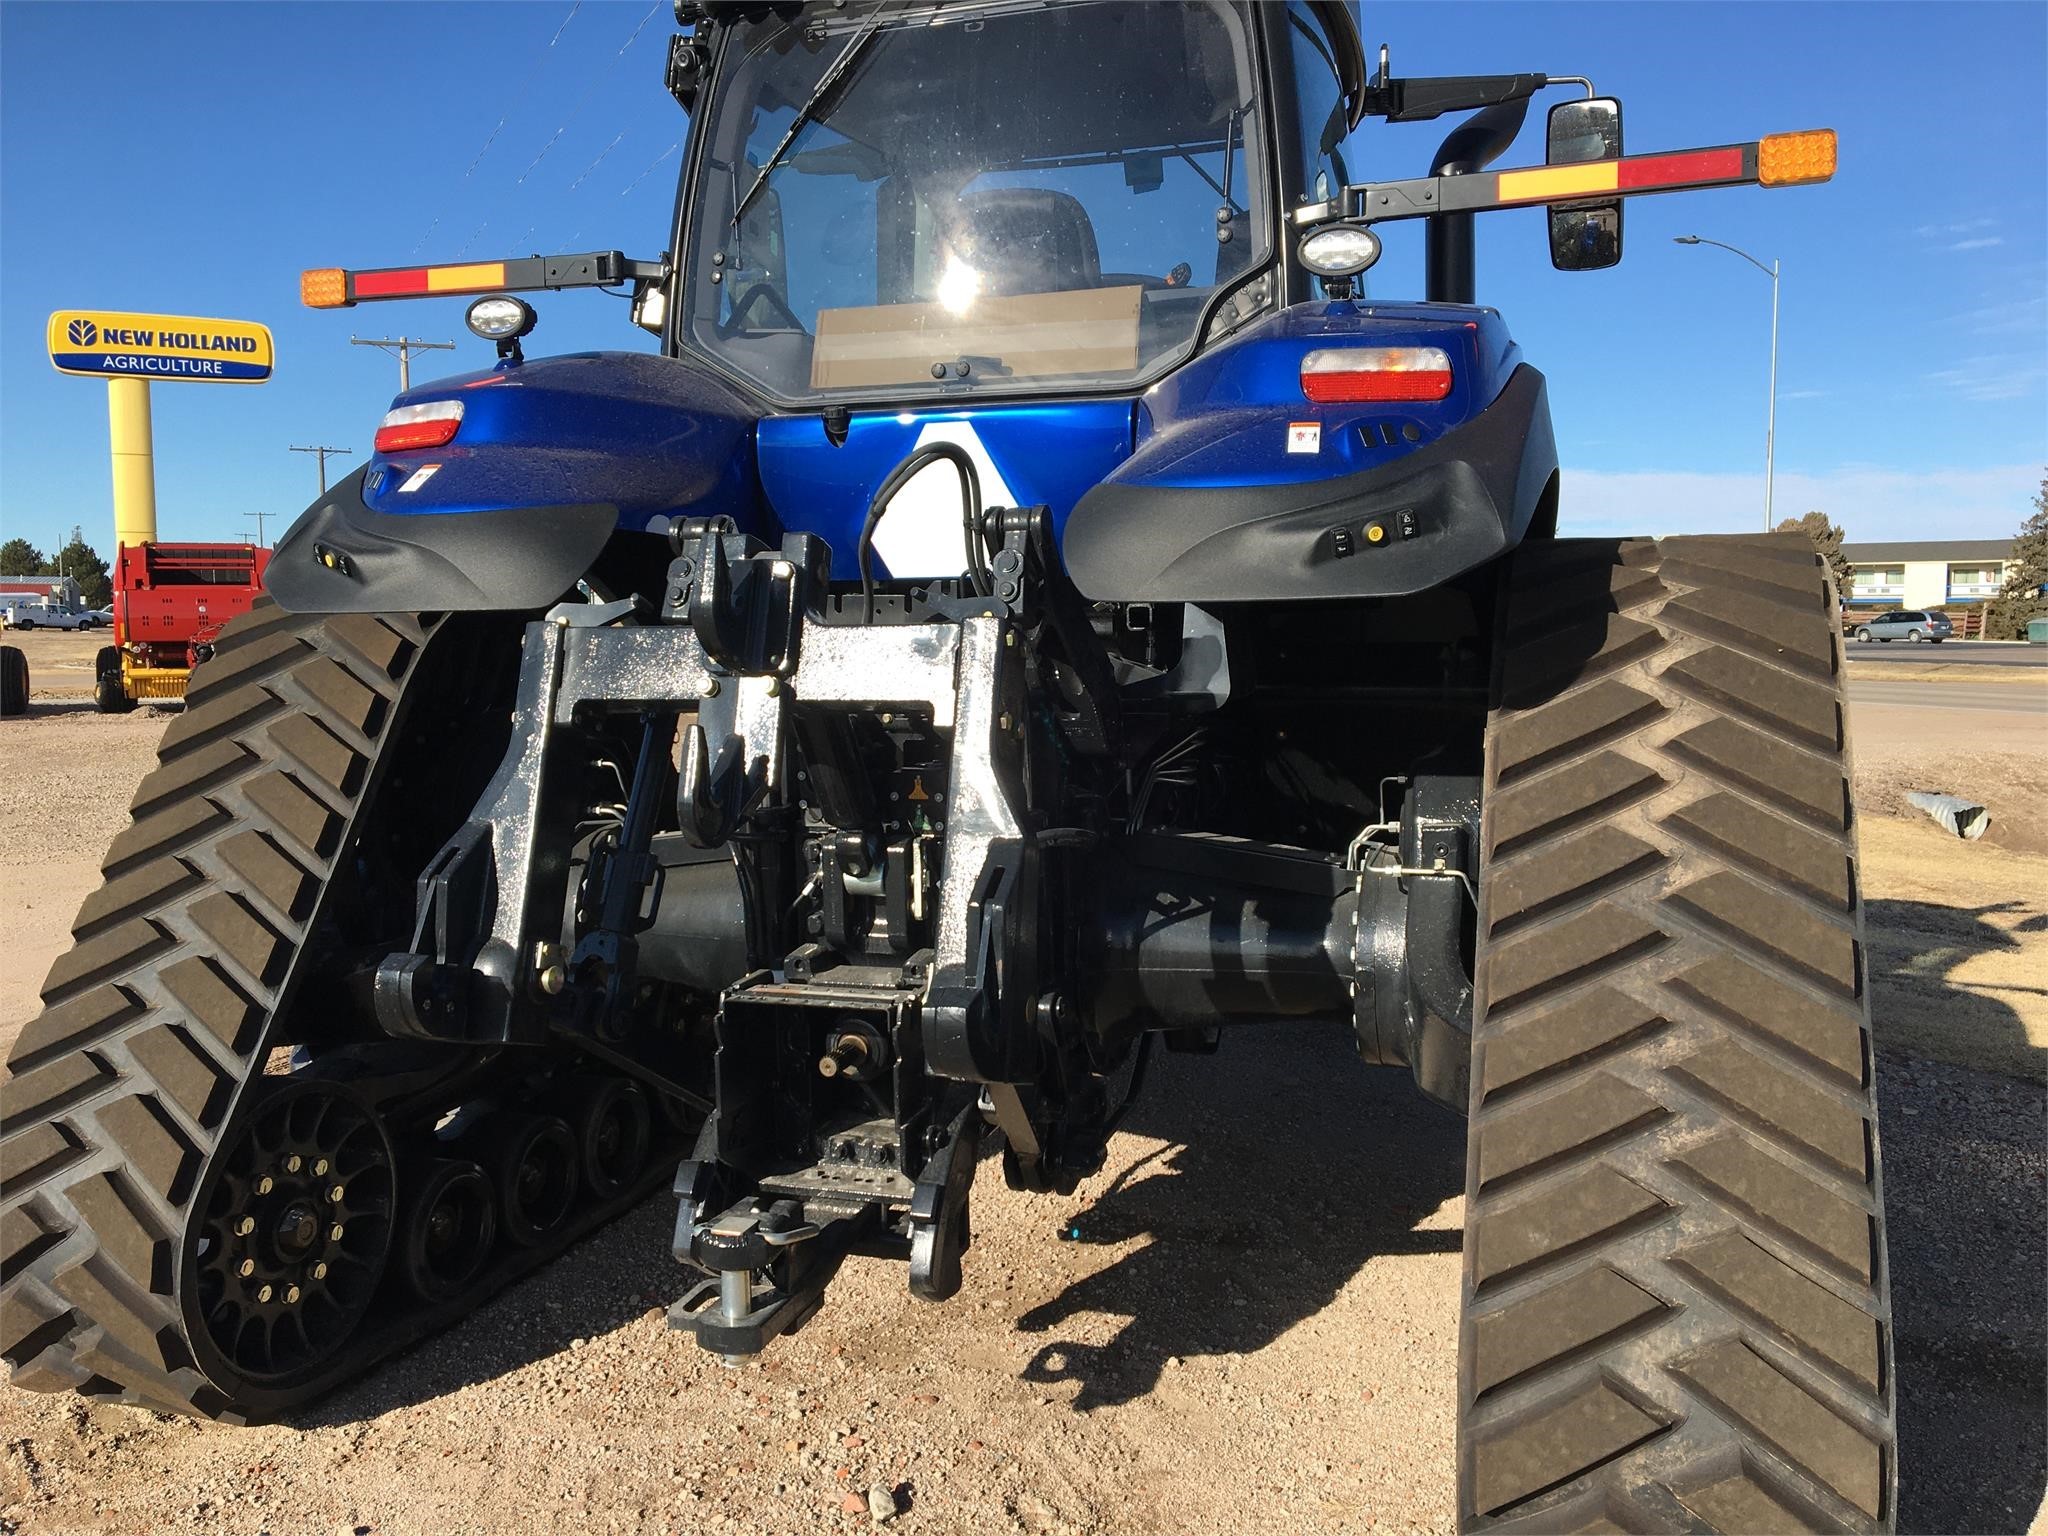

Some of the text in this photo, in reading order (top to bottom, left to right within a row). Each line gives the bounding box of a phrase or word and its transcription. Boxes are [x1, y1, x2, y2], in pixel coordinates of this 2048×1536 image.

[103, 328, 257, 353] NEW HOLLAND
[102, 355, 223, 374] AGRICULTURE
